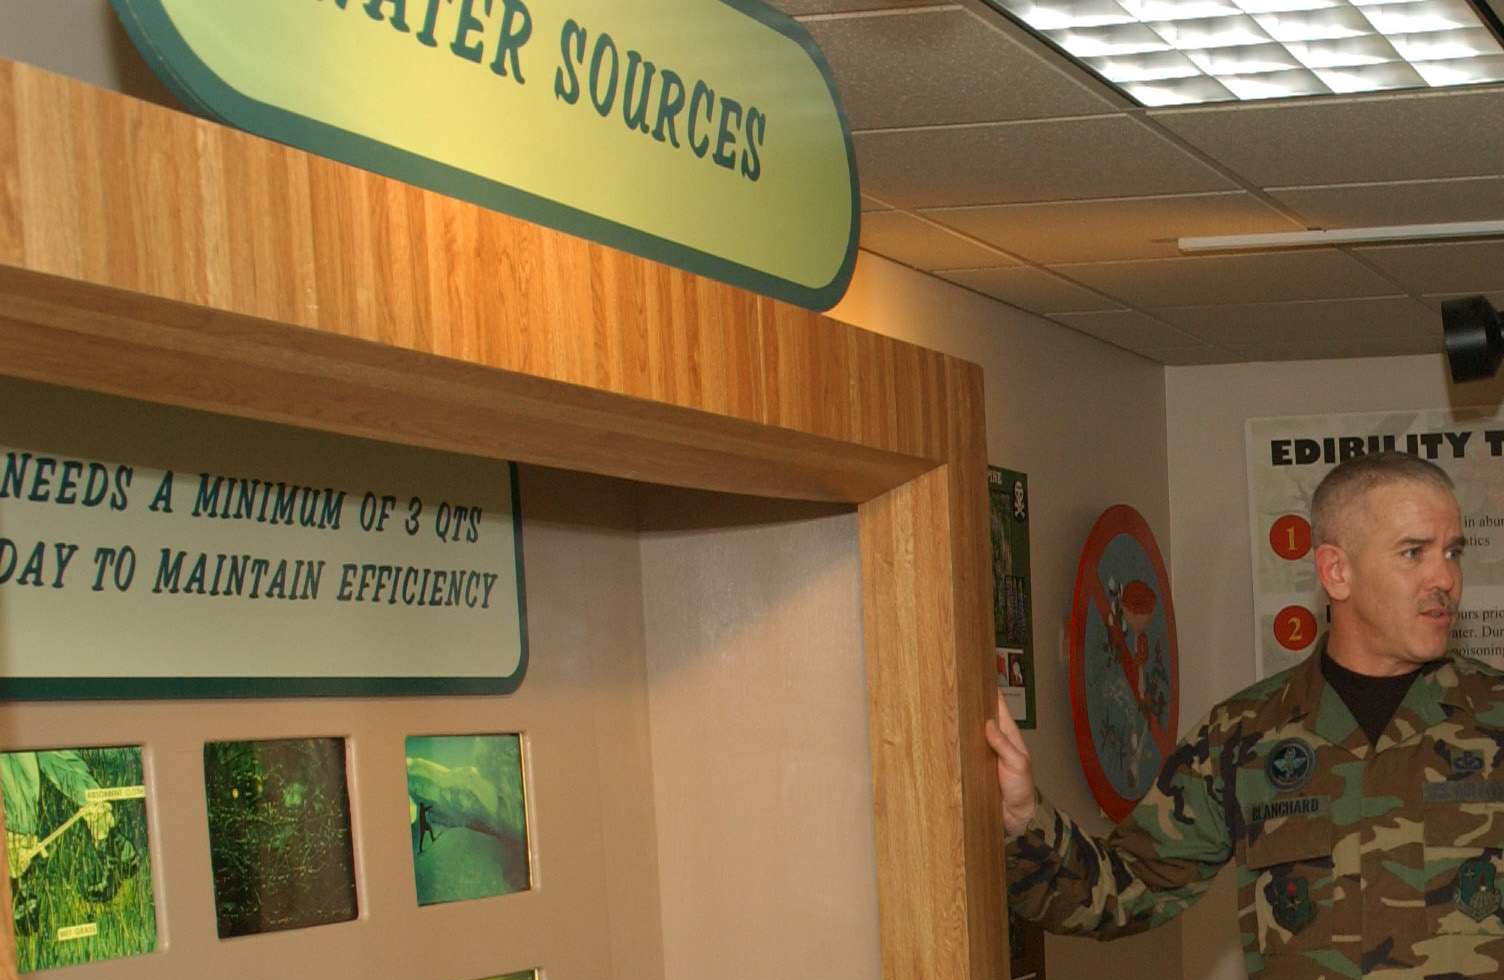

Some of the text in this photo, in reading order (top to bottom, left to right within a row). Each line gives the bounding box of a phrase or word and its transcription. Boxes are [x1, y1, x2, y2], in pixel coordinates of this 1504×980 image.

[316, 0, 766, 182] TER SOURCES
[0, 452, 482, 543] NEEDS A MINIMUM OF 3 QTS
[1464, 515, 1475, 528] in
[1285, 526, 1297, 551] 1
[0, 537, 498, 609] DAY TO MAINTAIN EFFICIENCY
[1287, 616, 1303, 641] 2
